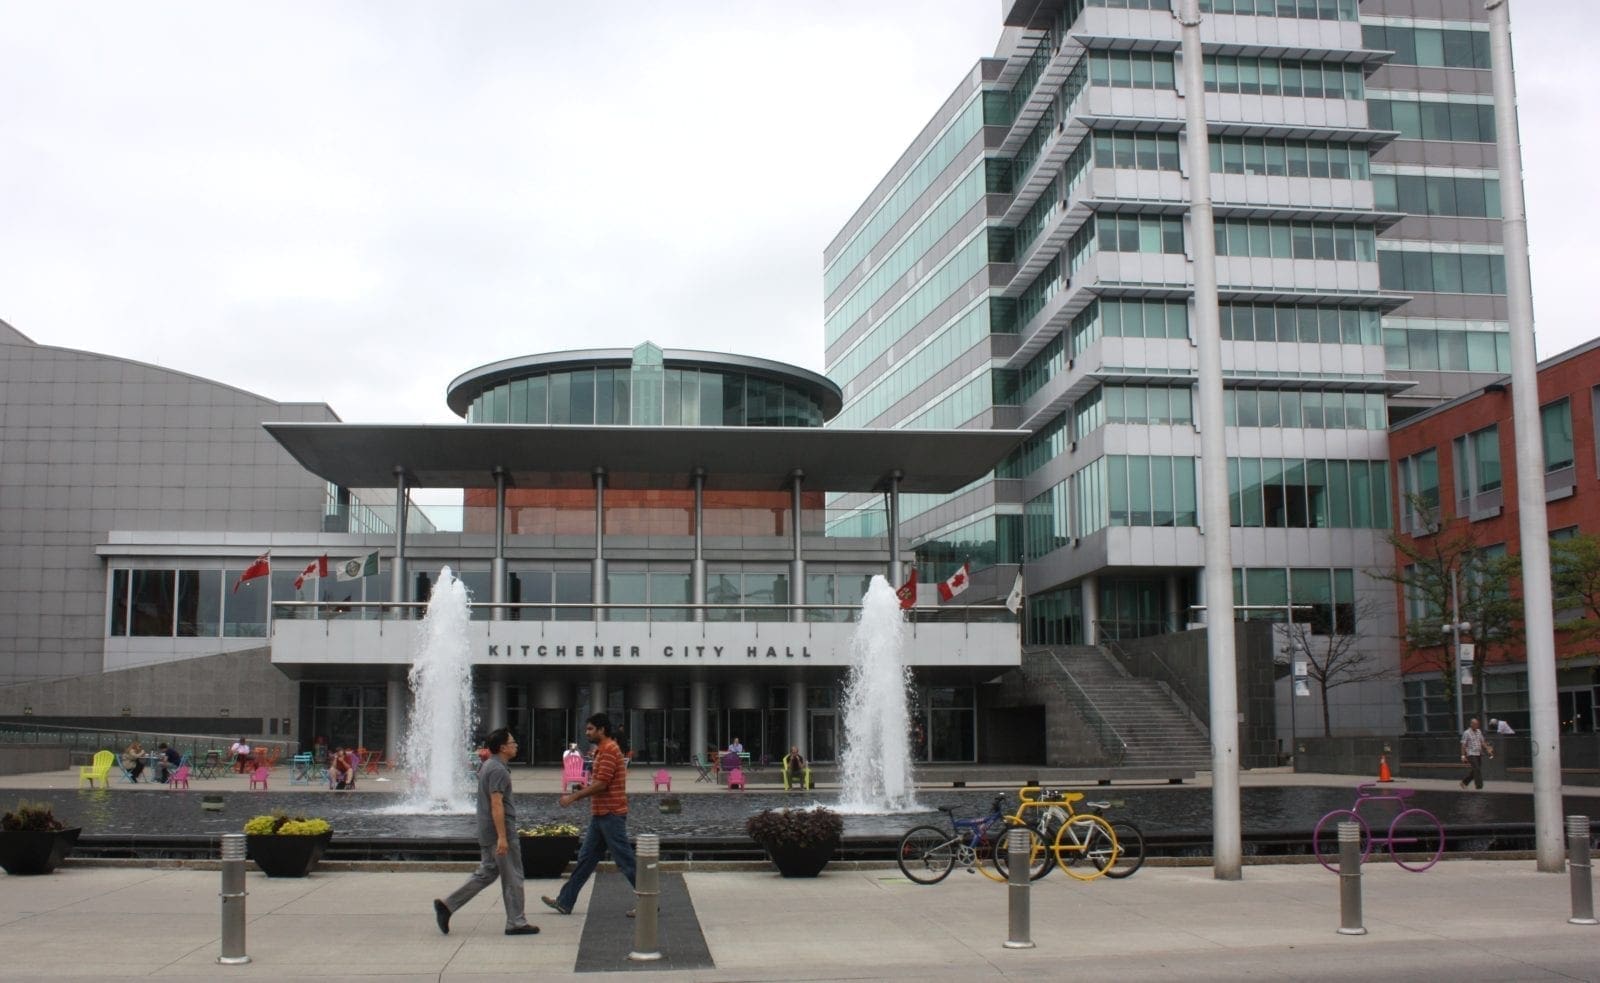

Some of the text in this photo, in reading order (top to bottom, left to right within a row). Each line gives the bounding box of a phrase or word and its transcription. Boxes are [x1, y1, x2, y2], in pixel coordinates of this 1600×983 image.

[488, 645, 811, 658] KITCHENER CITY HALL
